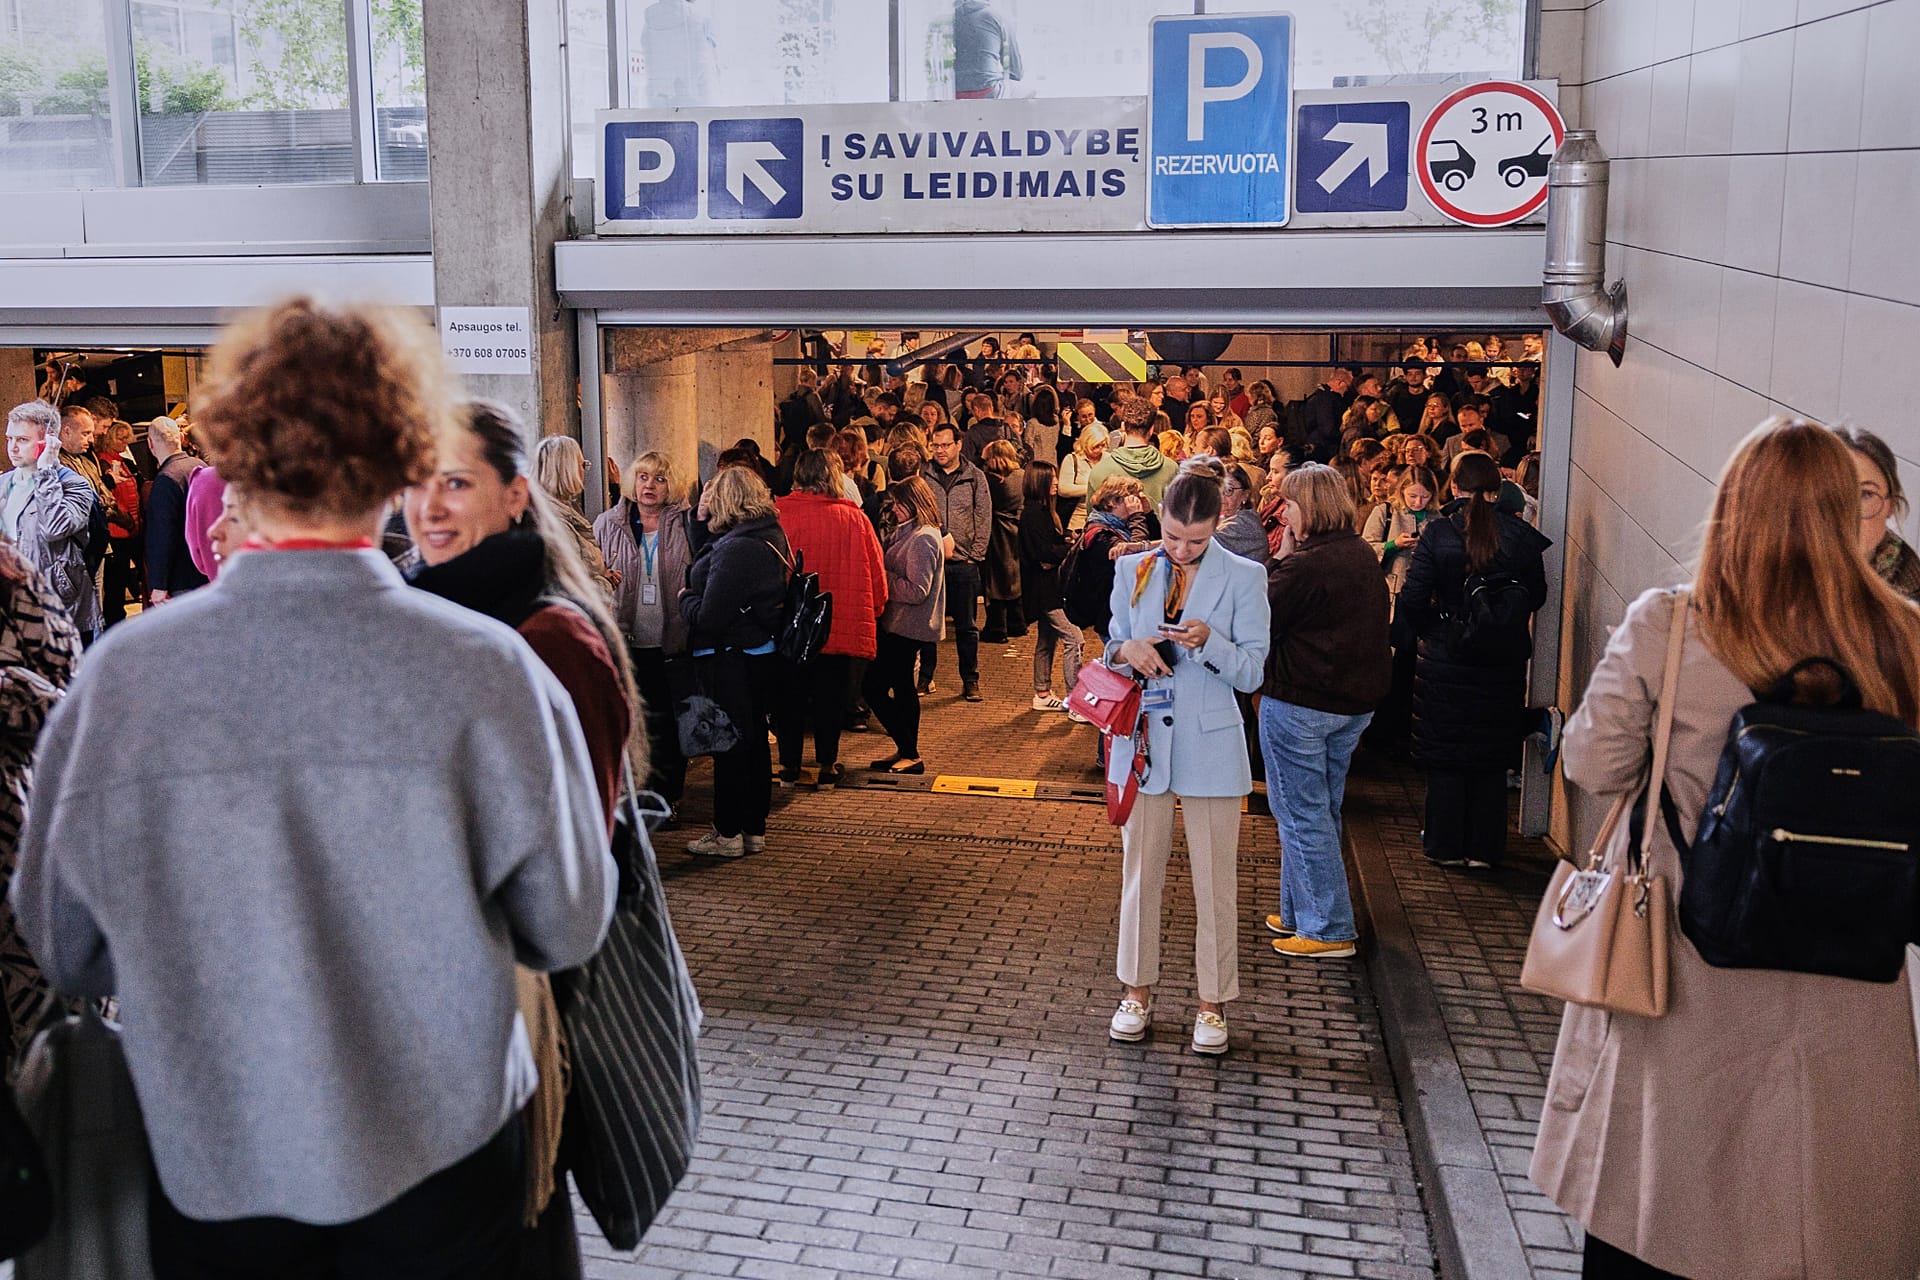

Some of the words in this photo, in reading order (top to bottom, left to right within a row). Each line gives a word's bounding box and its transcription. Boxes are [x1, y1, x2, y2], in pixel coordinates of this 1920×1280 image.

[1186, 32, 1263, 141] P
[1471, 108, 1488, 134] 3
[1496, 111, 1523, 132] m
[821, 134, 832, 168] Į
[844, 128, 1140, 163] SAVIVALDYBĘ
[624, 137, 676, 208] P
[1155, 152, 1280, 176] REZERVUOTA
[831, 173, 883, 201] SU
[903, 168, 1126, 200] LEIDIMAIS
[449, 322, 503, 334] Apsaugos
[505, 322, 522, 332] tel.
[474, 348, 493, 358] 608
[495, 348, 527, 358] 07005
